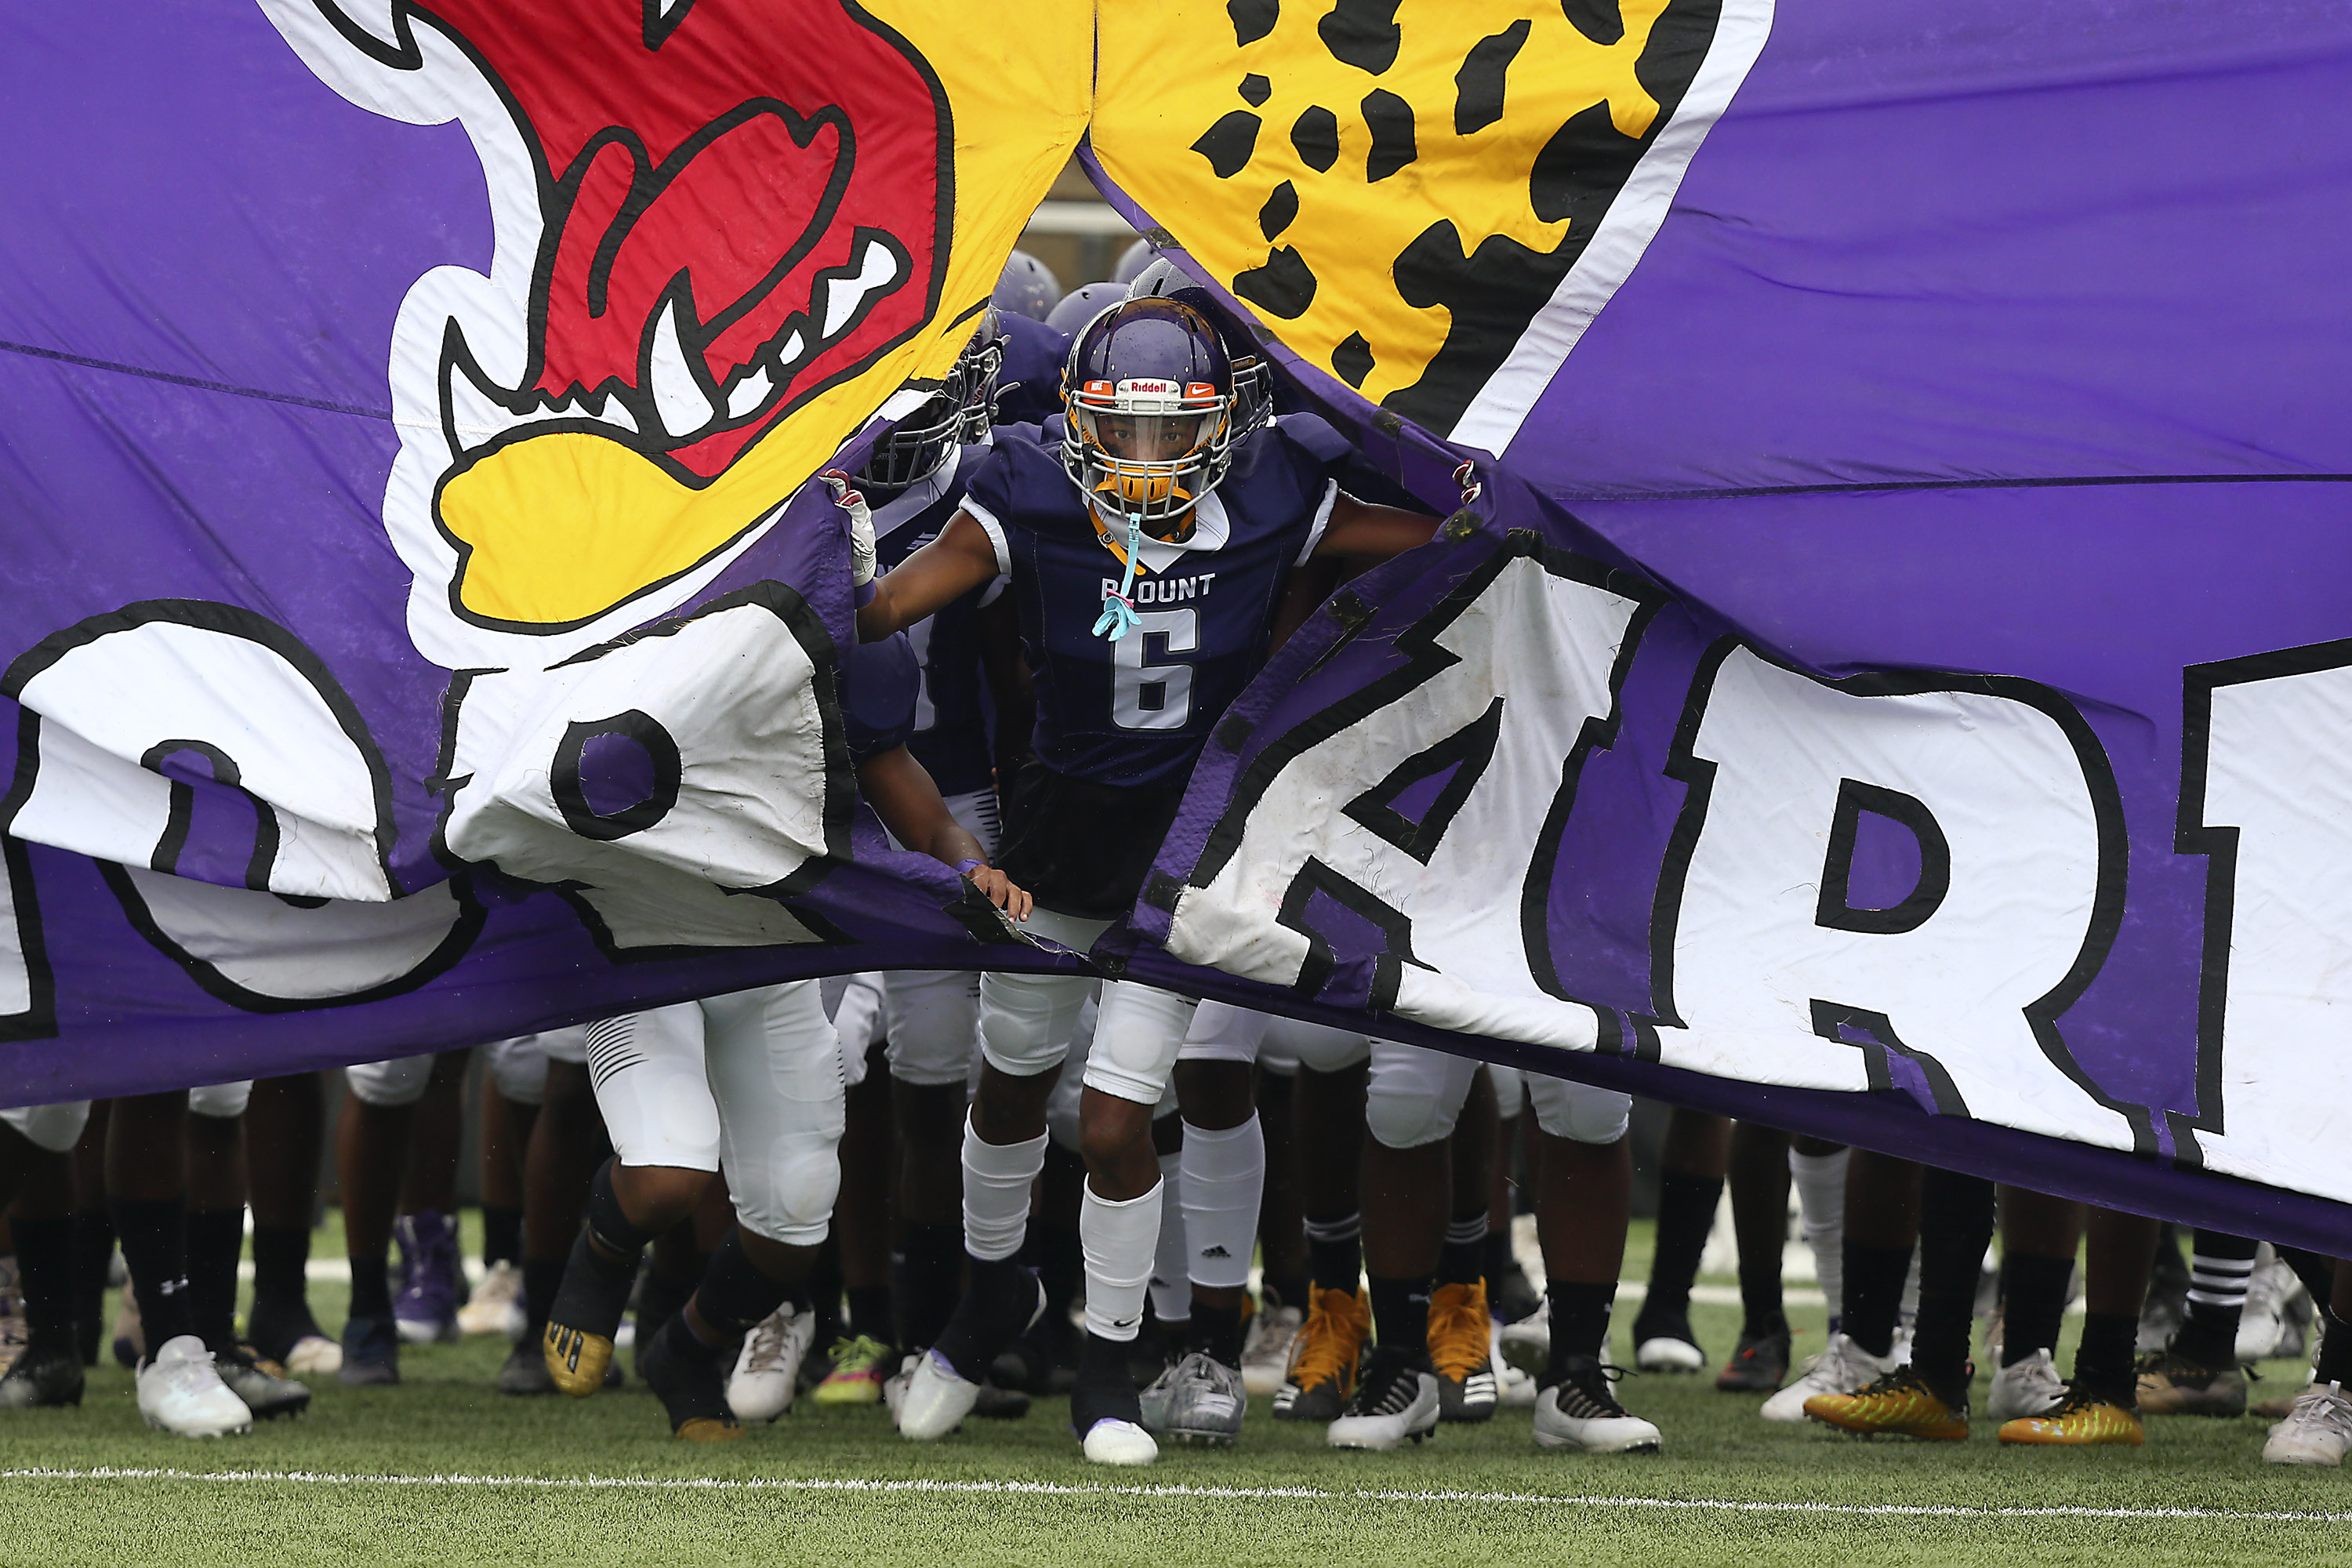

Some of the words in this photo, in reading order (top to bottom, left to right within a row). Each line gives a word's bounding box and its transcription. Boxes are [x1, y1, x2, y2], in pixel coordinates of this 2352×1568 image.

[1131, 382, 1167, 393] Riddell
[1101, 573, 1216, 604] BOUNT
[1111, 607, 1199, 731] 6
